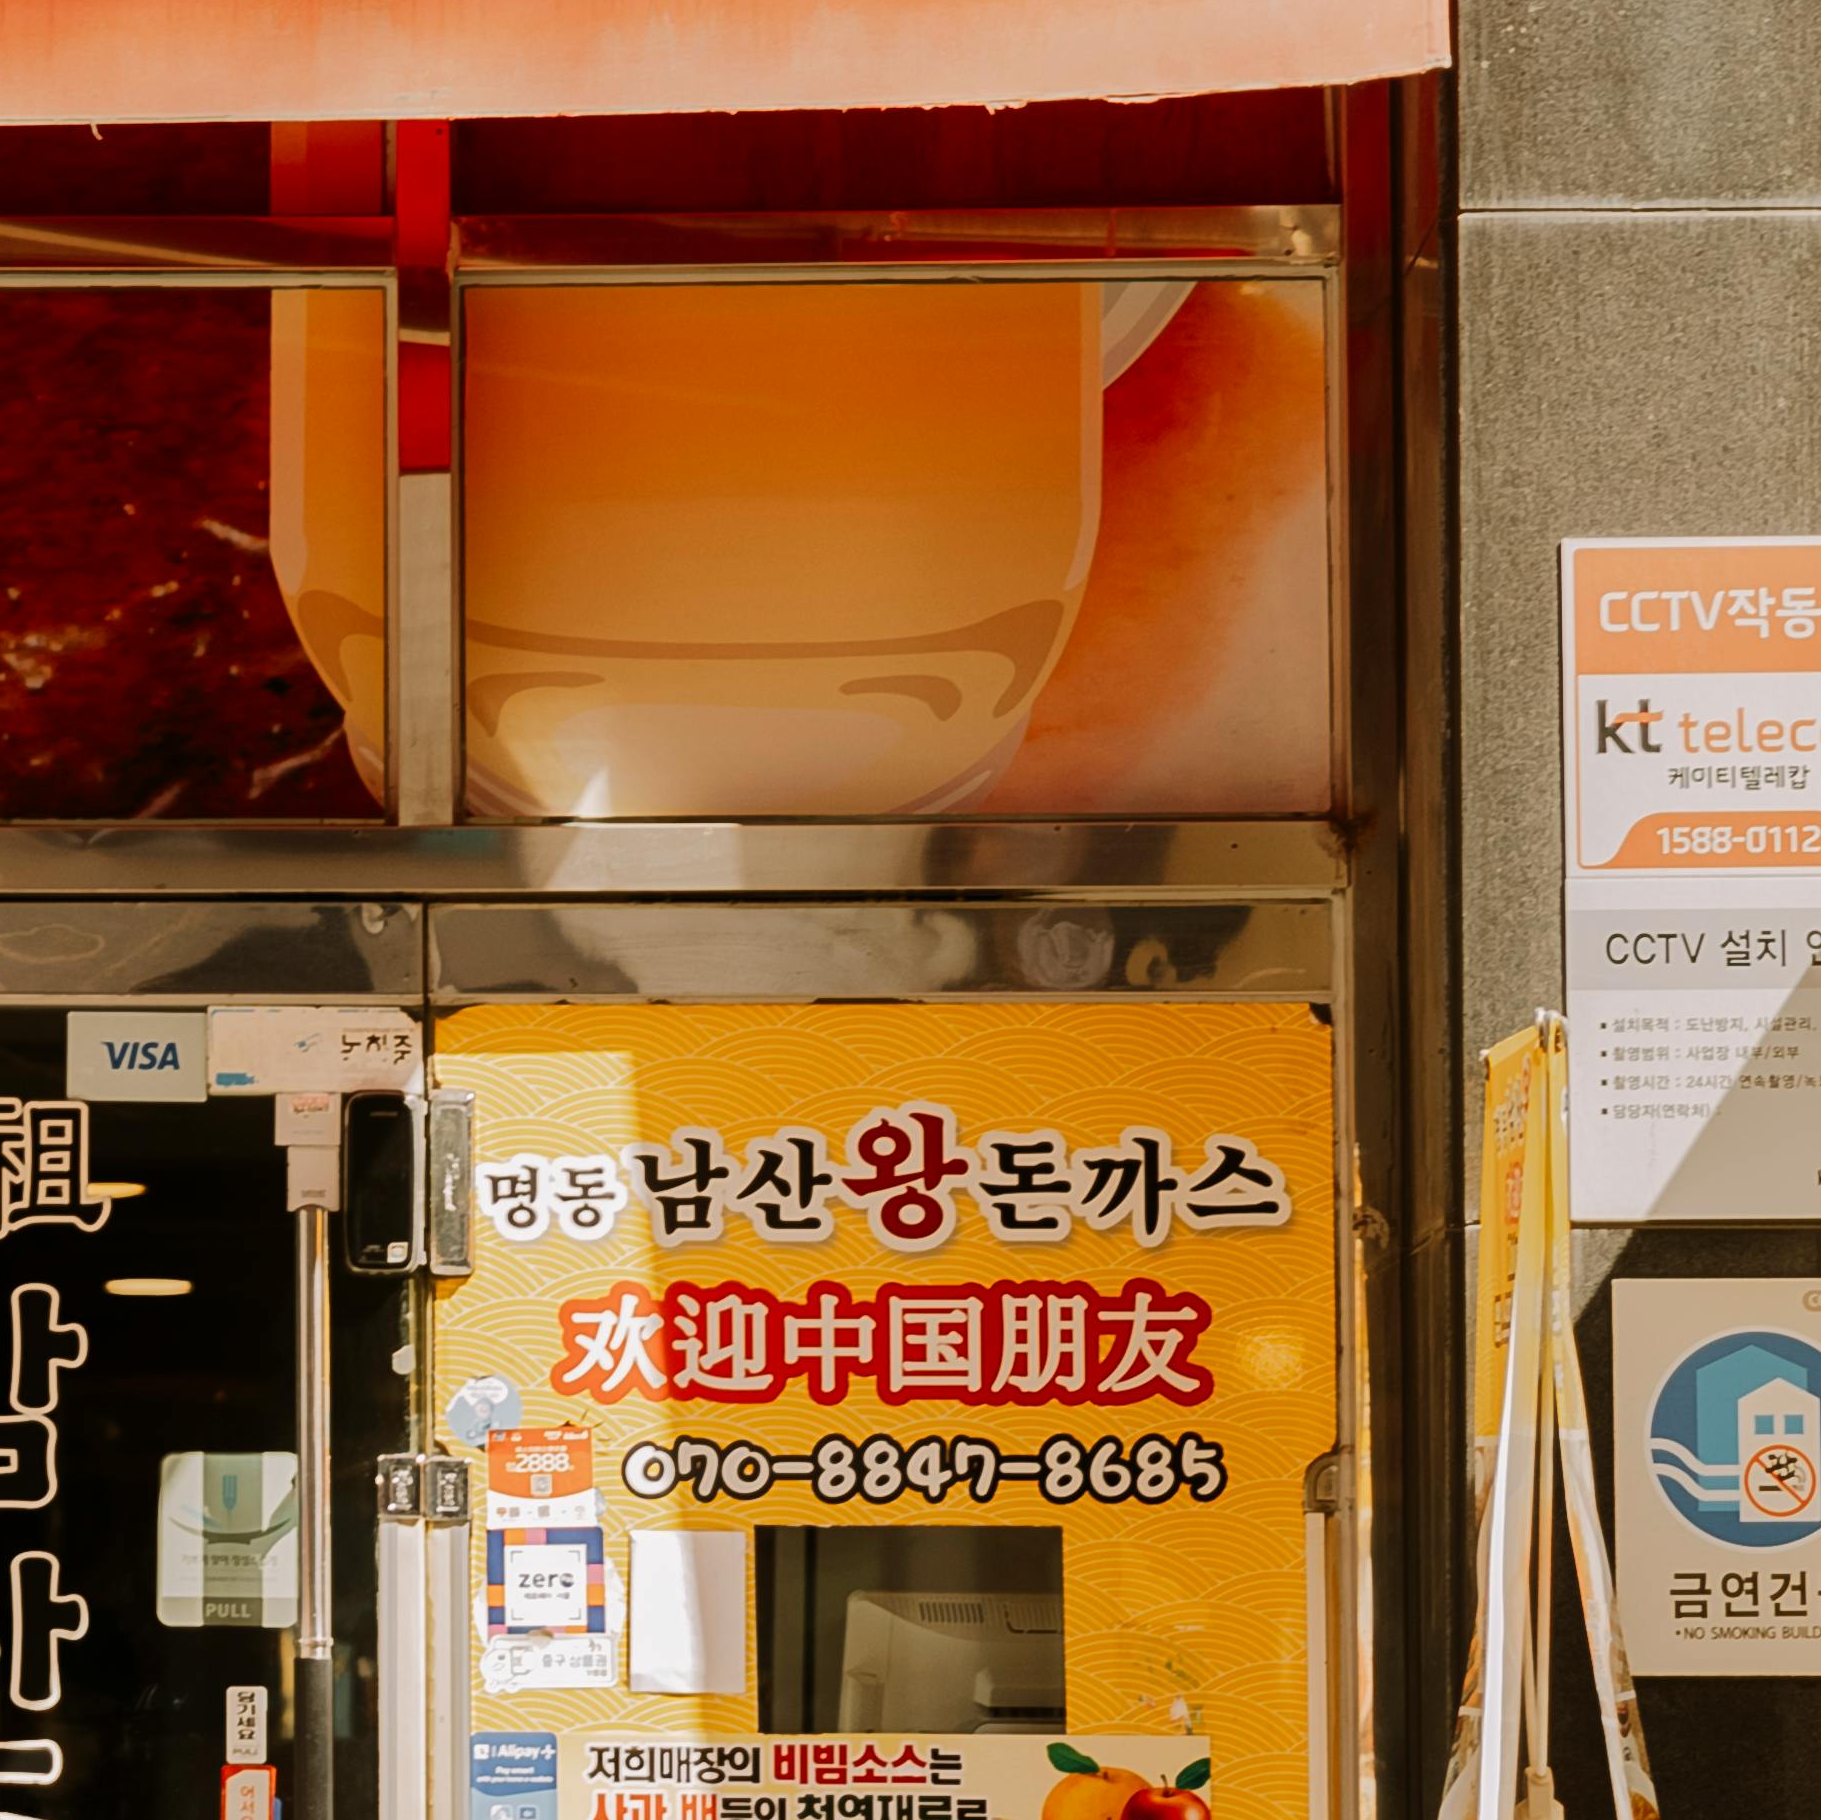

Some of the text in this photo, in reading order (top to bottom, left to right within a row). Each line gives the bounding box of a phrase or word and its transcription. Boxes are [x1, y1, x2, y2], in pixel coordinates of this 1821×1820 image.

[1595, 699, 1821, 755] kt telec
[1668, 764, 1810, 791] 케이티텔레캅
[1605, 929, 1788, 967] CCTV 설치
[101, 1041, 181, 1071] VISA
[483, 1164, 618, 1230] 명동
[557, 1285, 1207, 1400] 欢迎中国朋友
[623, 1434, 1226, 1504] 070-8847-8685
[205, 1602, 252, 1618] PULL
[1669, 1569, 1821, 1620] 금연건
[1683, 1626, 1705, 1640] NO
[1711, 1626, 1776, 1640] SMOKING
[587, 1743, 963, 1785] 저희매장의 비빔소스는
